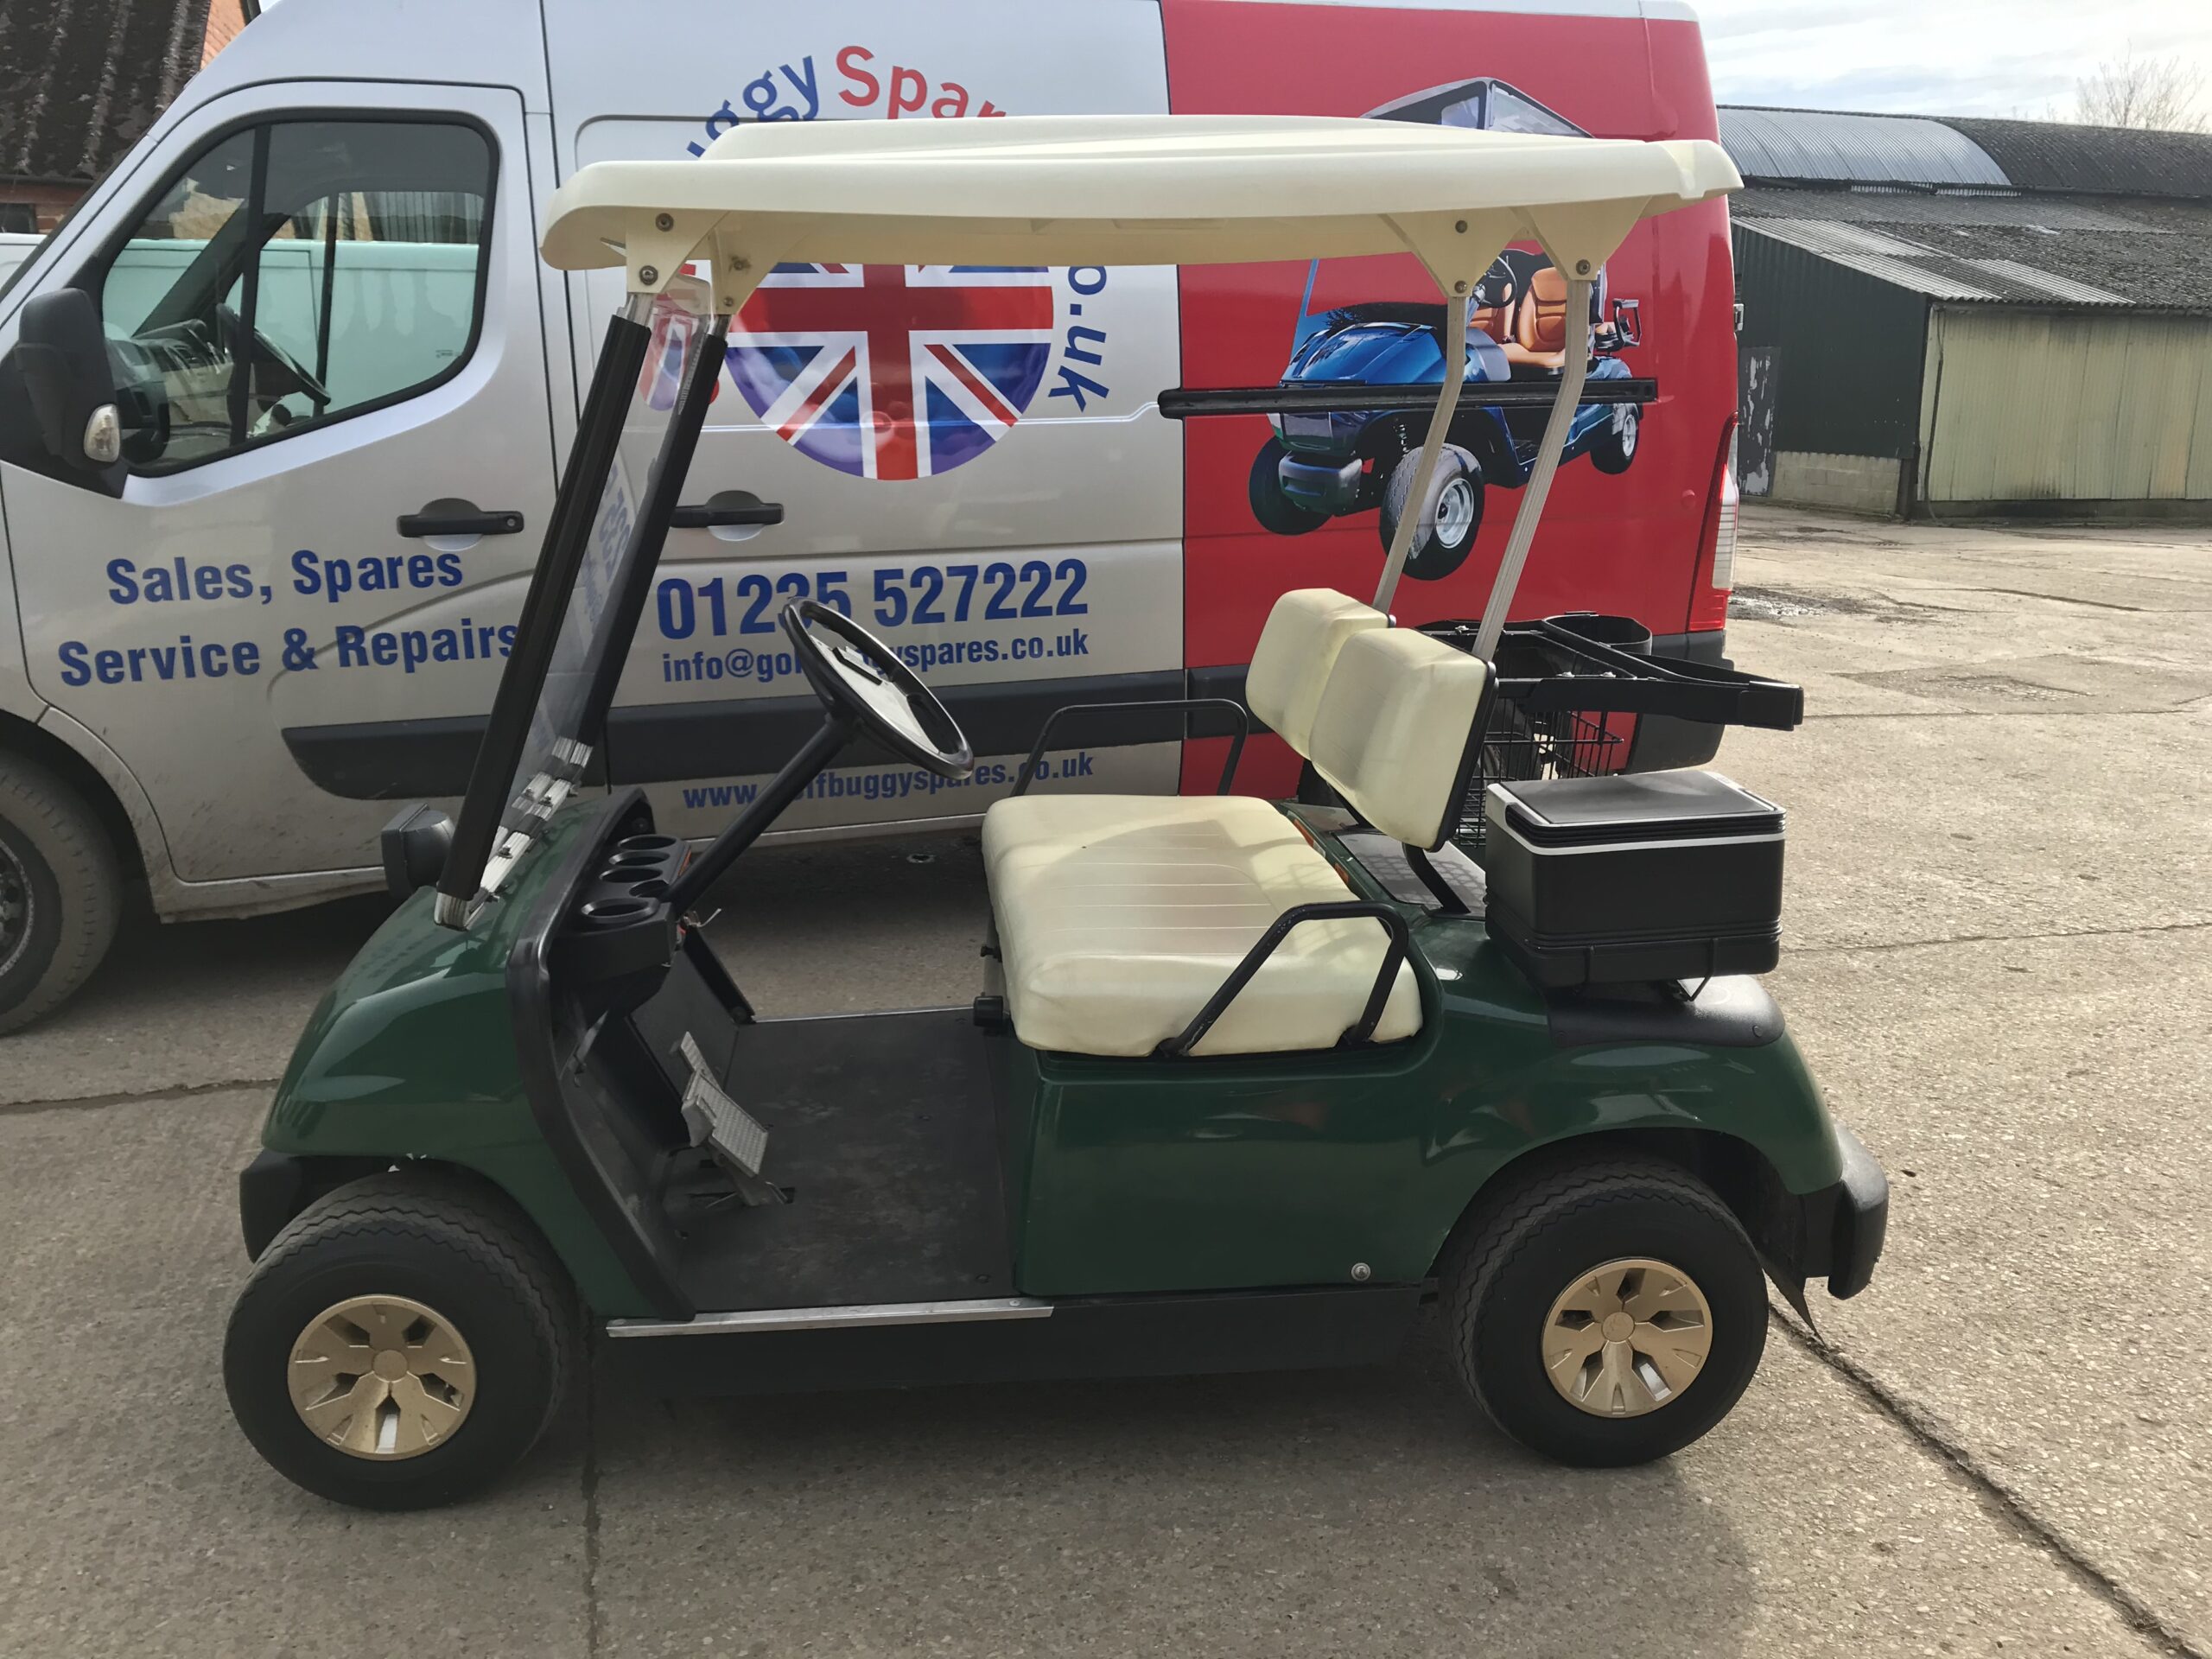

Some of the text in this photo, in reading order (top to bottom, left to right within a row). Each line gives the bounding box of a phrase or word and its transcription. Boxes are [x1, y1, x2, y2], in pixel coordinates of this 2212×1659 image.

[106, 550, 463, 605] Sales, Spares
[657, 571, 851, 639] 01235
[874, 558, 1089, 626] 527222
[58, 619, 518, 686] Service & Repairs
